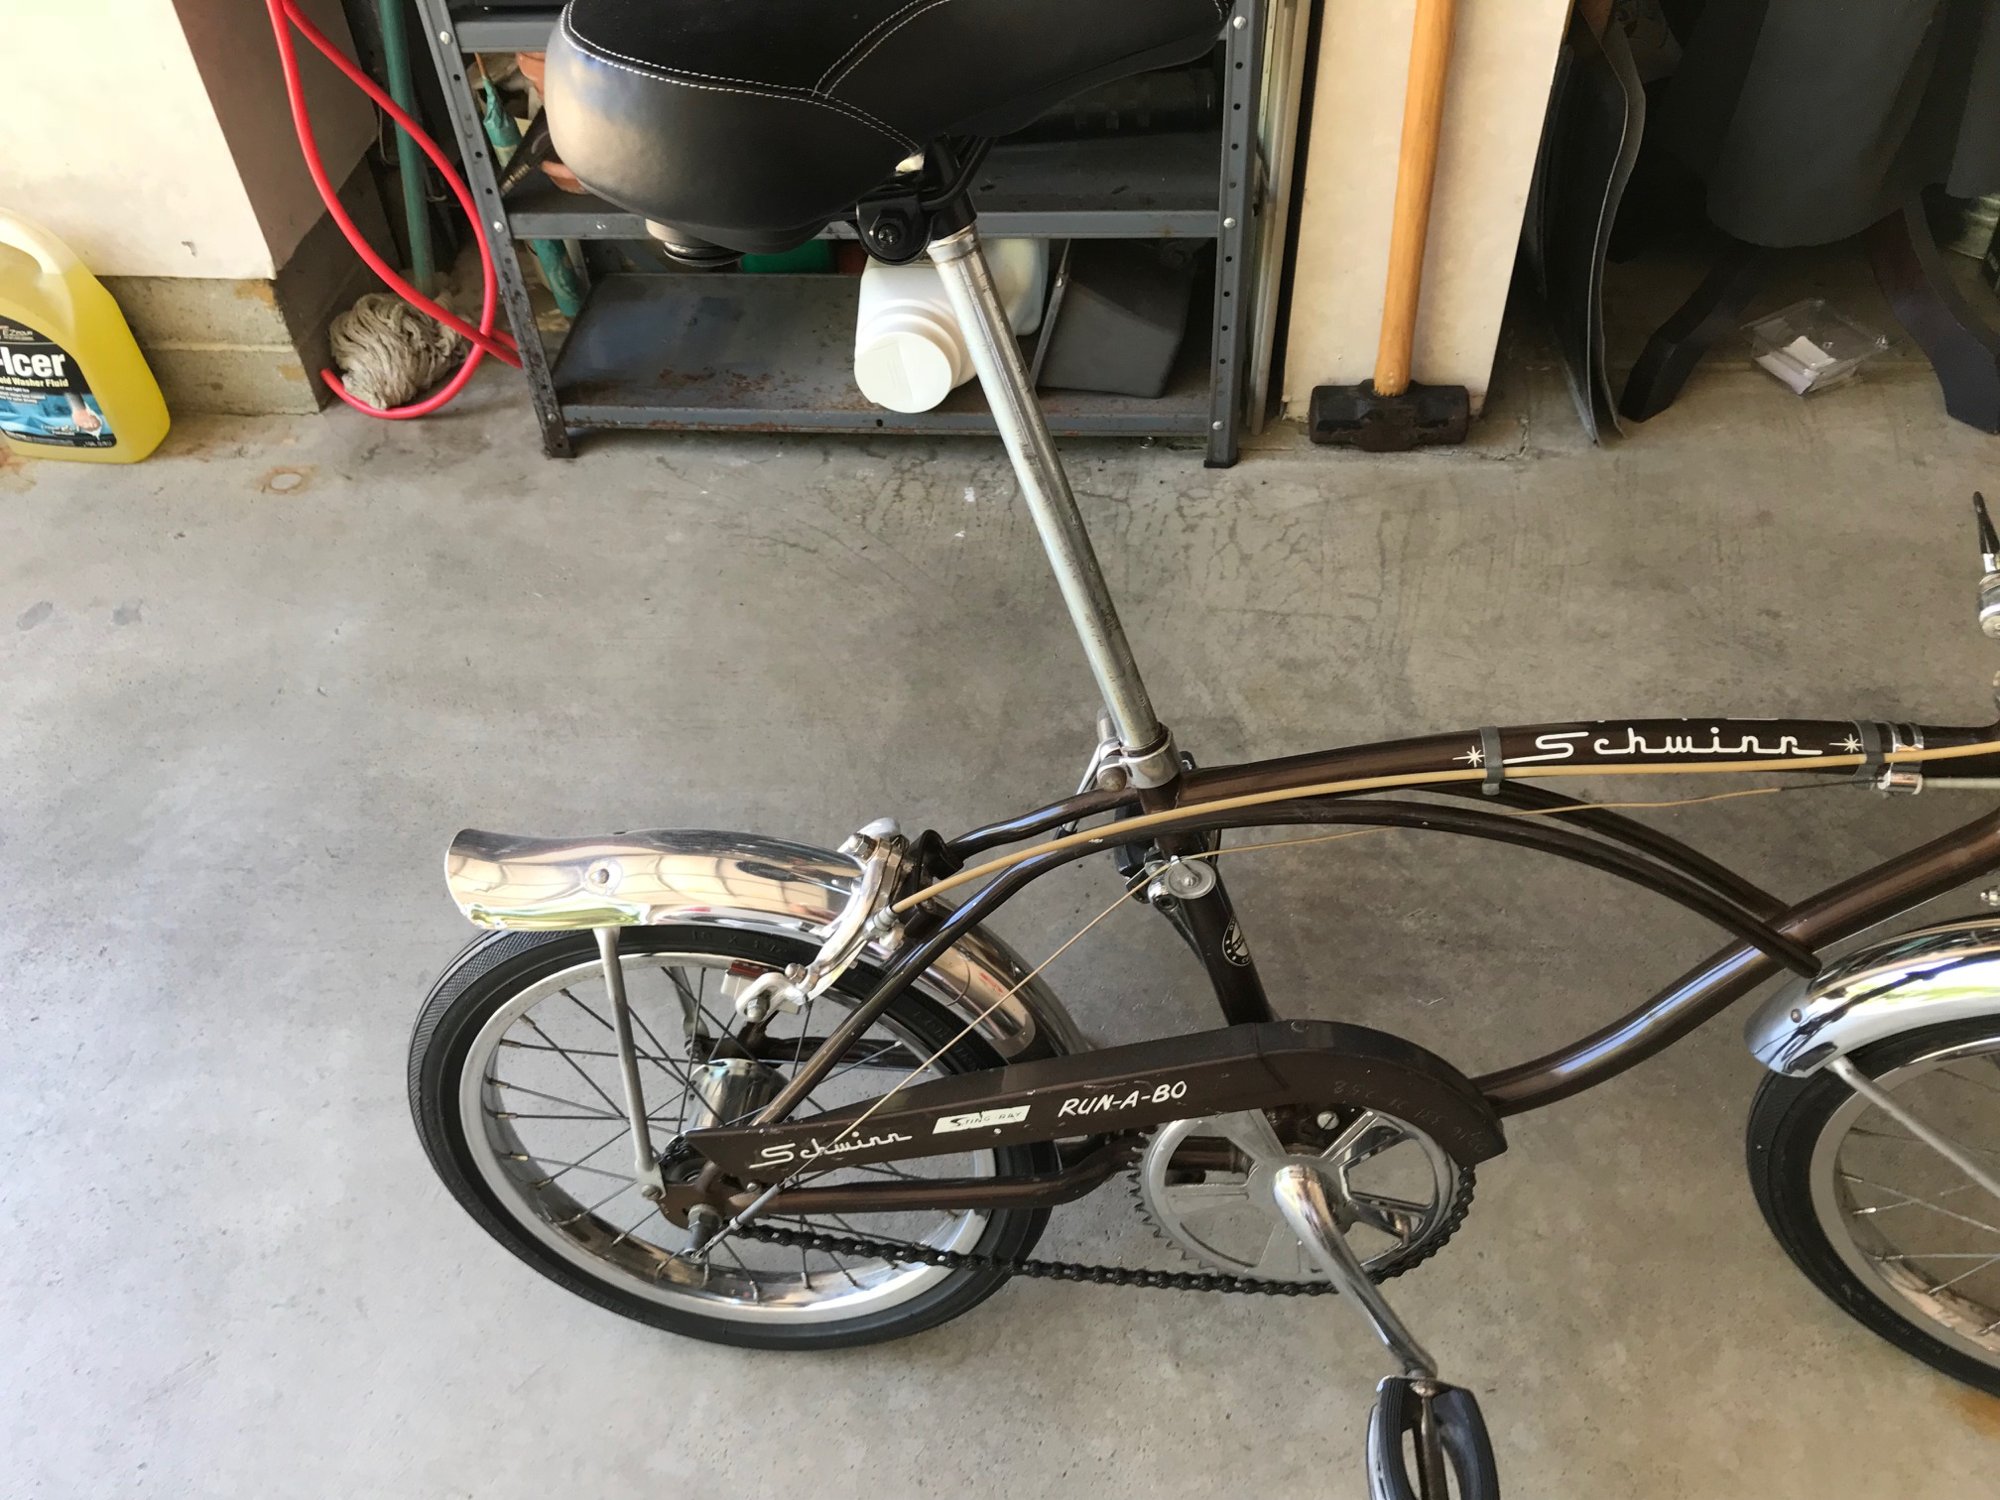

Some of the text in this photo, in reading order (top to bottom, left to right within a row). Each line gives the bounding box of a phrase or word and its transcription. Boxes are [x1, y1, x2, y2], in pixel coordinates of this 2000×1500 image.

[12, 377, 44, 387] Washer
[45, 378, 69, 388] Fluid
[1502, 727, 1823, 764] Schwinn
[1058, 1080, 1187, 1118] RUN-A-BO
[749, 1131, 913, 1169] Schwinn
